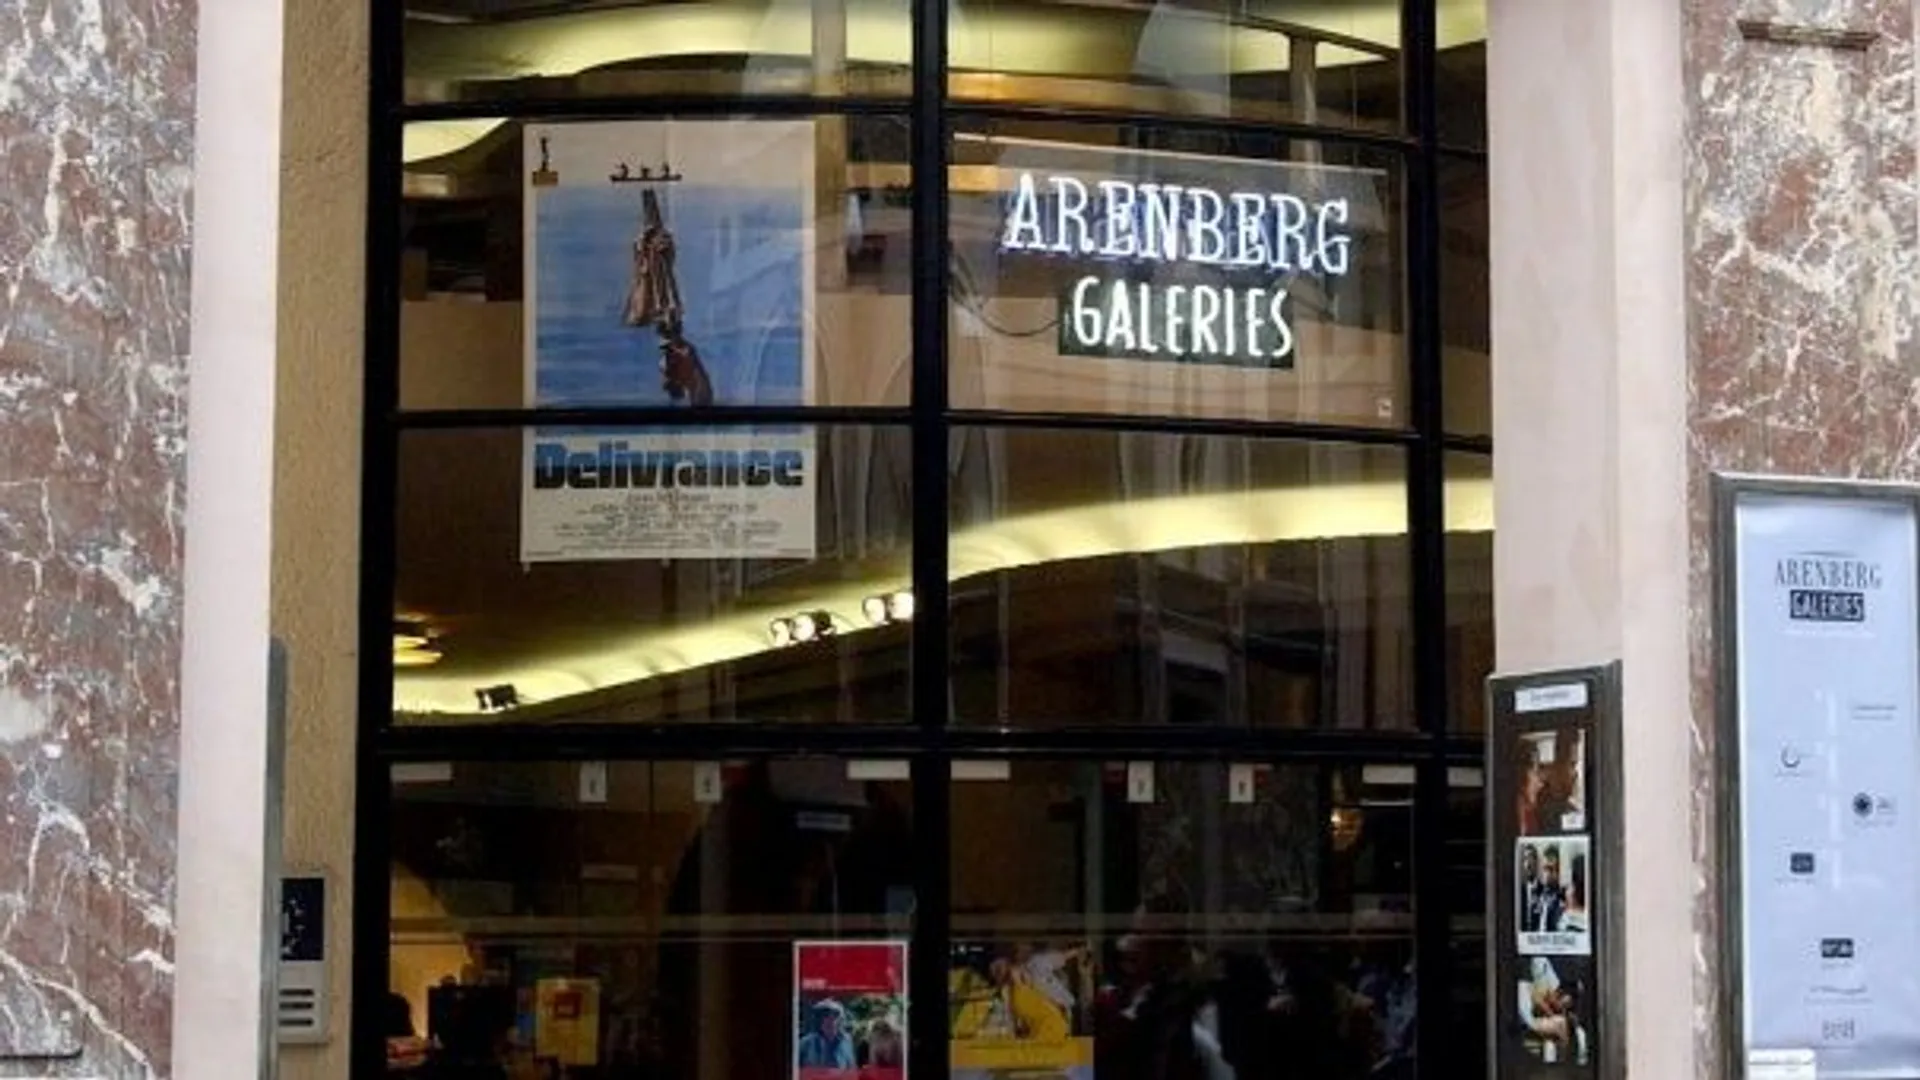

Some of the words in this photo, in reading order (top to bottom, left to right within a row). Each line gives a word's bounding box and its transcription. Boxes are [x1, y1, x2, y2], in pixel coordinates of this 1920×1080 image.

[1001, 172, 1352, 275] ARENBERG
[1072, 275, 1294, 359] GALERIES
[1774, 558, 1882, 589] ARENBERG
